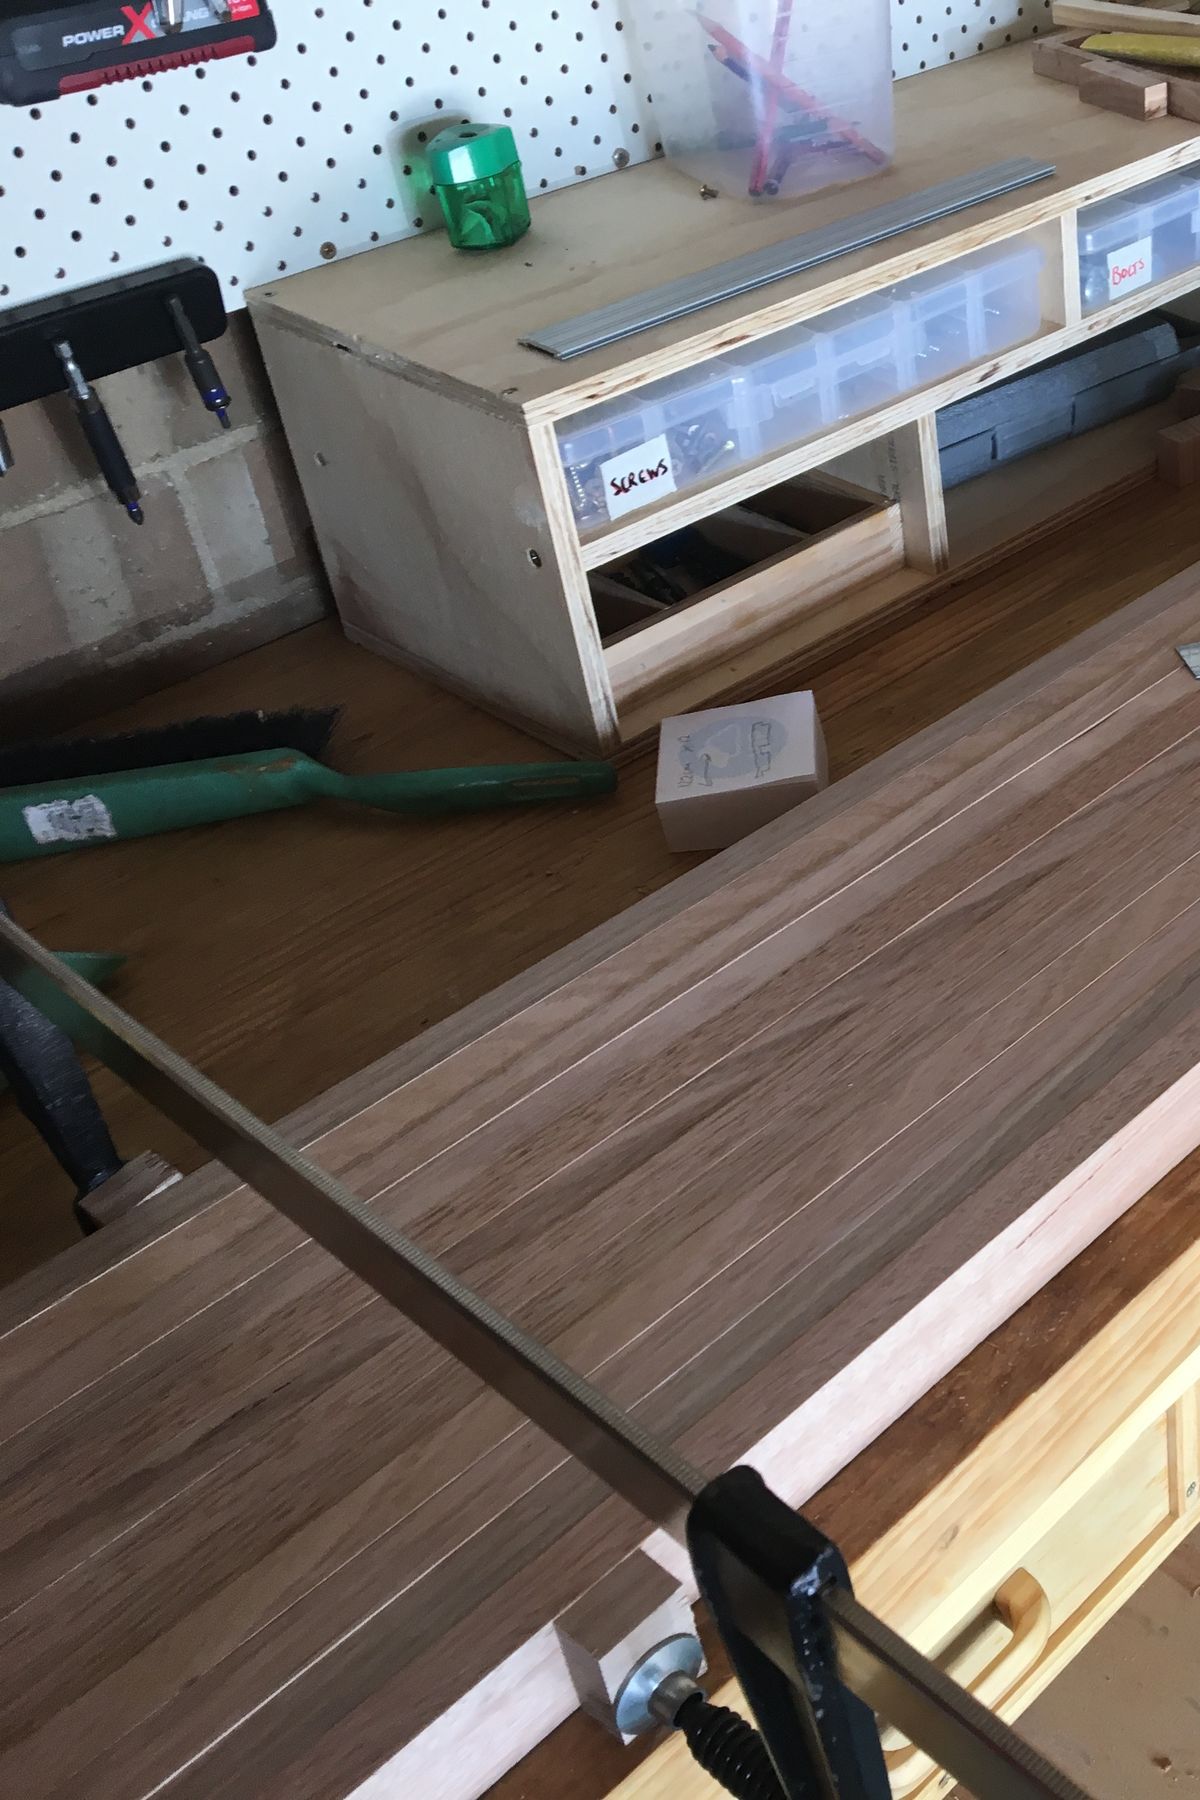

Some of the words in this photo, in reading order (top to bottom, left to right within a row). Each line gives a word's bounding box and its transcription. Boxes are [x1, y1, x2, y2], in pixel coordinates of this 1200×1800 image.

[62, 24, 125, 47] POWER
[1112, 258, 1145, 286] BOLTS
[609, 458, 668, 496] SCREWS
